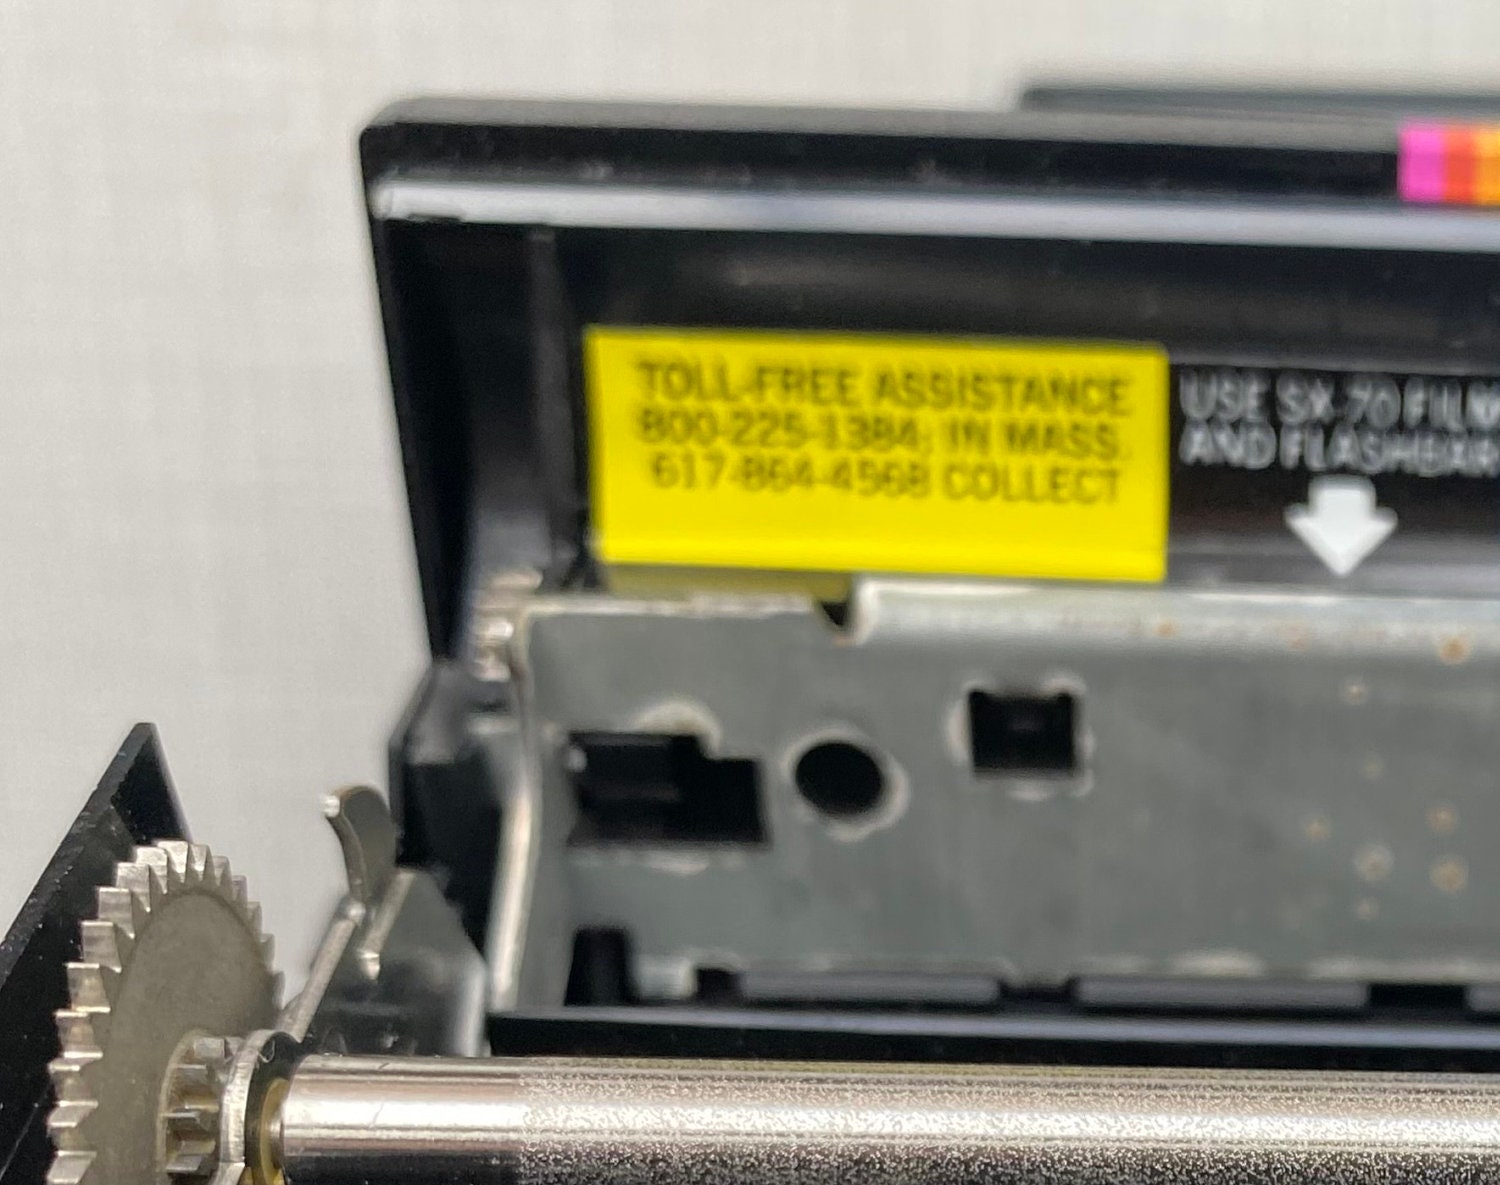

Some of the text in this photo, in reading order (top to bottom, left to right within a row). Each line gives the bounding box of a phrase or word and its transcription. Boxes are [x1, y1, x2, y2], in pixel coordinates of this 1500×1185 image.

[635, 358, 1134, 416] TOLL-FREE ASSISTANCE
[1178, 366, 1271, 423] USE
[946, 417, 993, 456] IN
[1178, 418, 1276, 469] AND
[943, 460, 1124, 506] COLLECT
